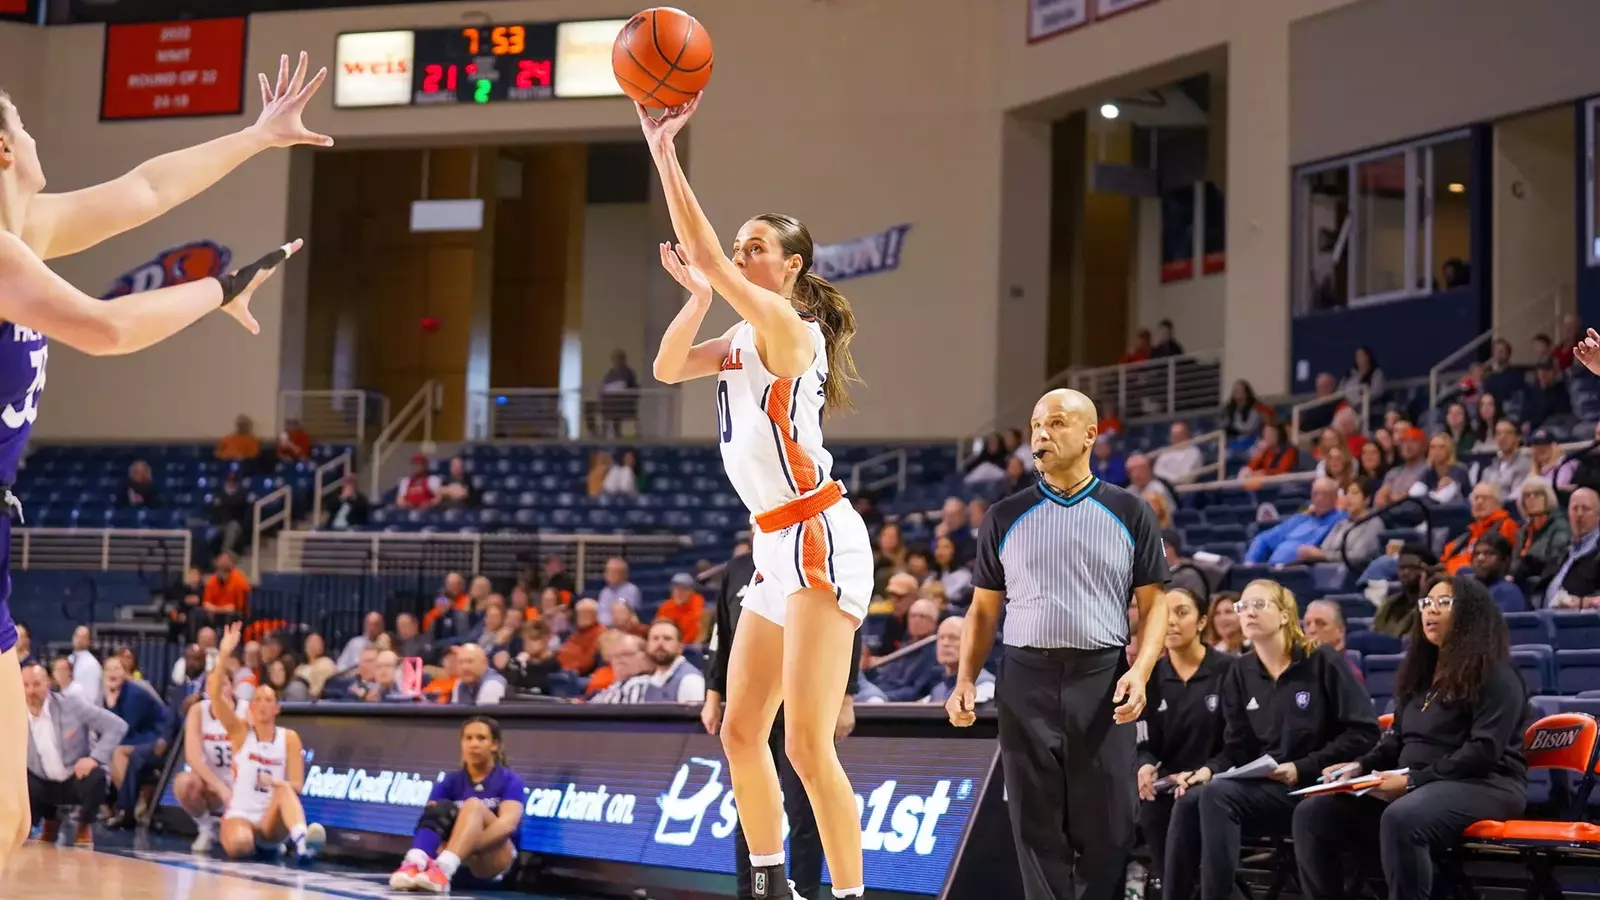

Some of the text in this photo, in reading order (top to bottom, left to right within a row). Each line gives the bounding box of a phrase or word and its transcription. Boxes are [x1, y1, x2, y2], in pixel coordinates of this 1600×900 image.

[423, 64, 457, 93] 21
[516, 60, 551, 88] 24
[474, 79, 491, 103] 2
[716, 380, 732, 443] 0
[302, 765, 355, 799] Federal
[348, 769, 394, 802] Credit
[388, 772, 433, 807] Union
[526, 788, 561, 818] can
[558, 783, 609, 822] bank
